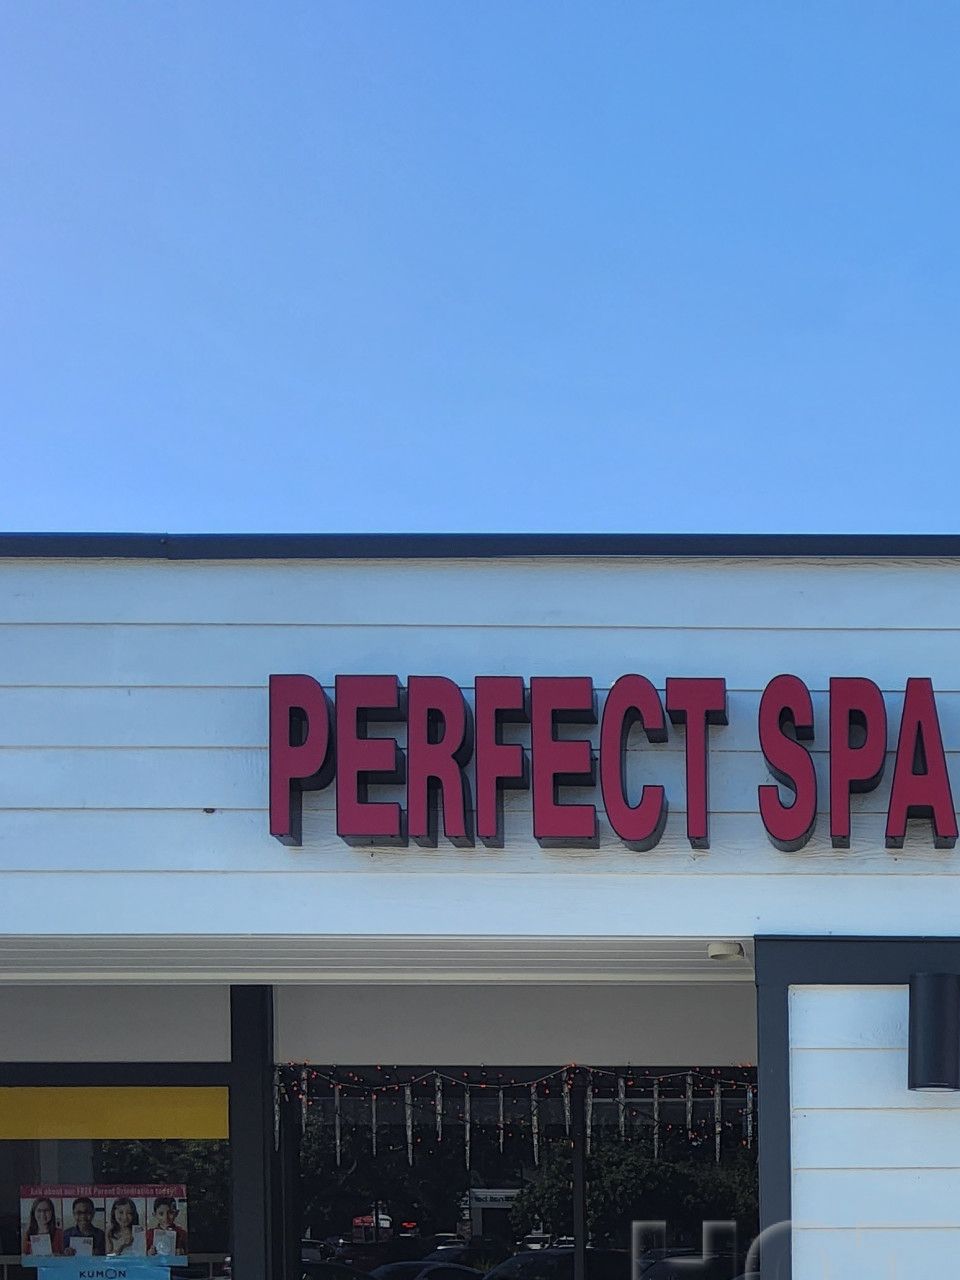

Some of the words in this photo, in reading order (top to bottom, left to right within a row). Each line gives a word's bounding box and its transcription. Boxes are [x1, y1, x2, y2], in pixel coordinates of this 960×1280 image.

[268, 673, 730, 848] PERFECT
[757, 673, 960, 851] SPA
[79, 1268, 128, 1280] KUMON
